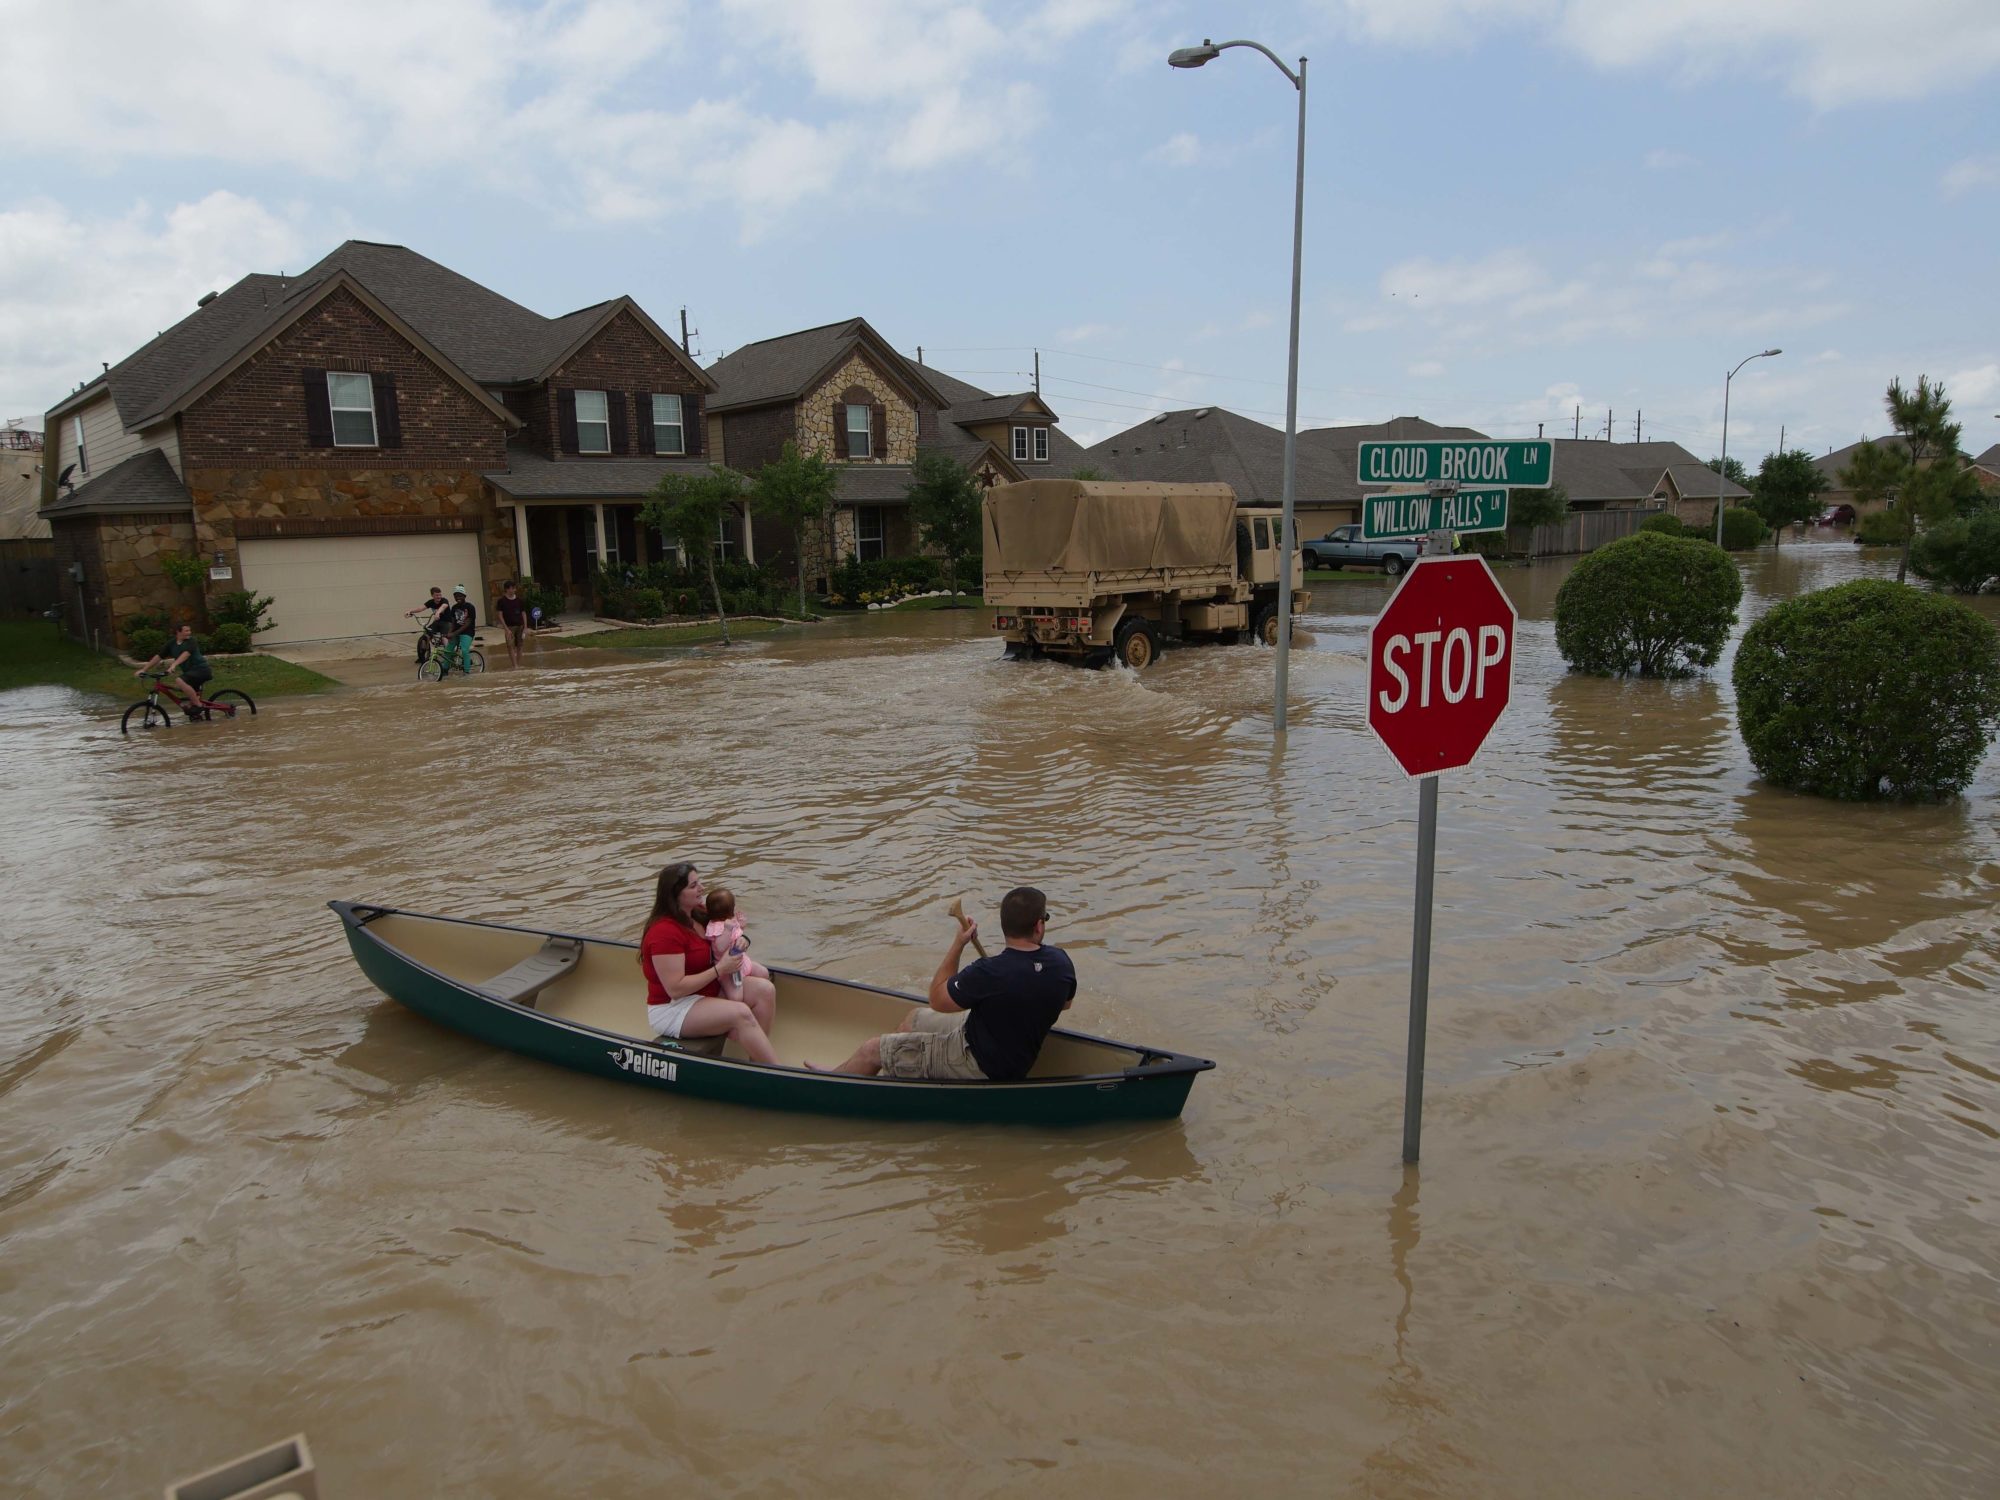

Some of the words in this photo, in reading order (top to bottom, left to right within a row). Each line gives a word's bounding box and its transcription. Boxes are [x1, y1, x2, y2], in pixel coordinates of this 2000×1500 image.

[1370, 447, 1428, 479] CLOUD
[1440, 446, 1510, 480] BROOK
[1523, 447, 1538, 465] LN
[1373, 498, 1432, 534] WILLOW
[1440, 495, 1483, 529] FALLS
[1490, 495, 1500, 511] LN
[1379, 624, 1506, 714] STOP
[621, 1047, 677, 1082] Pelican
